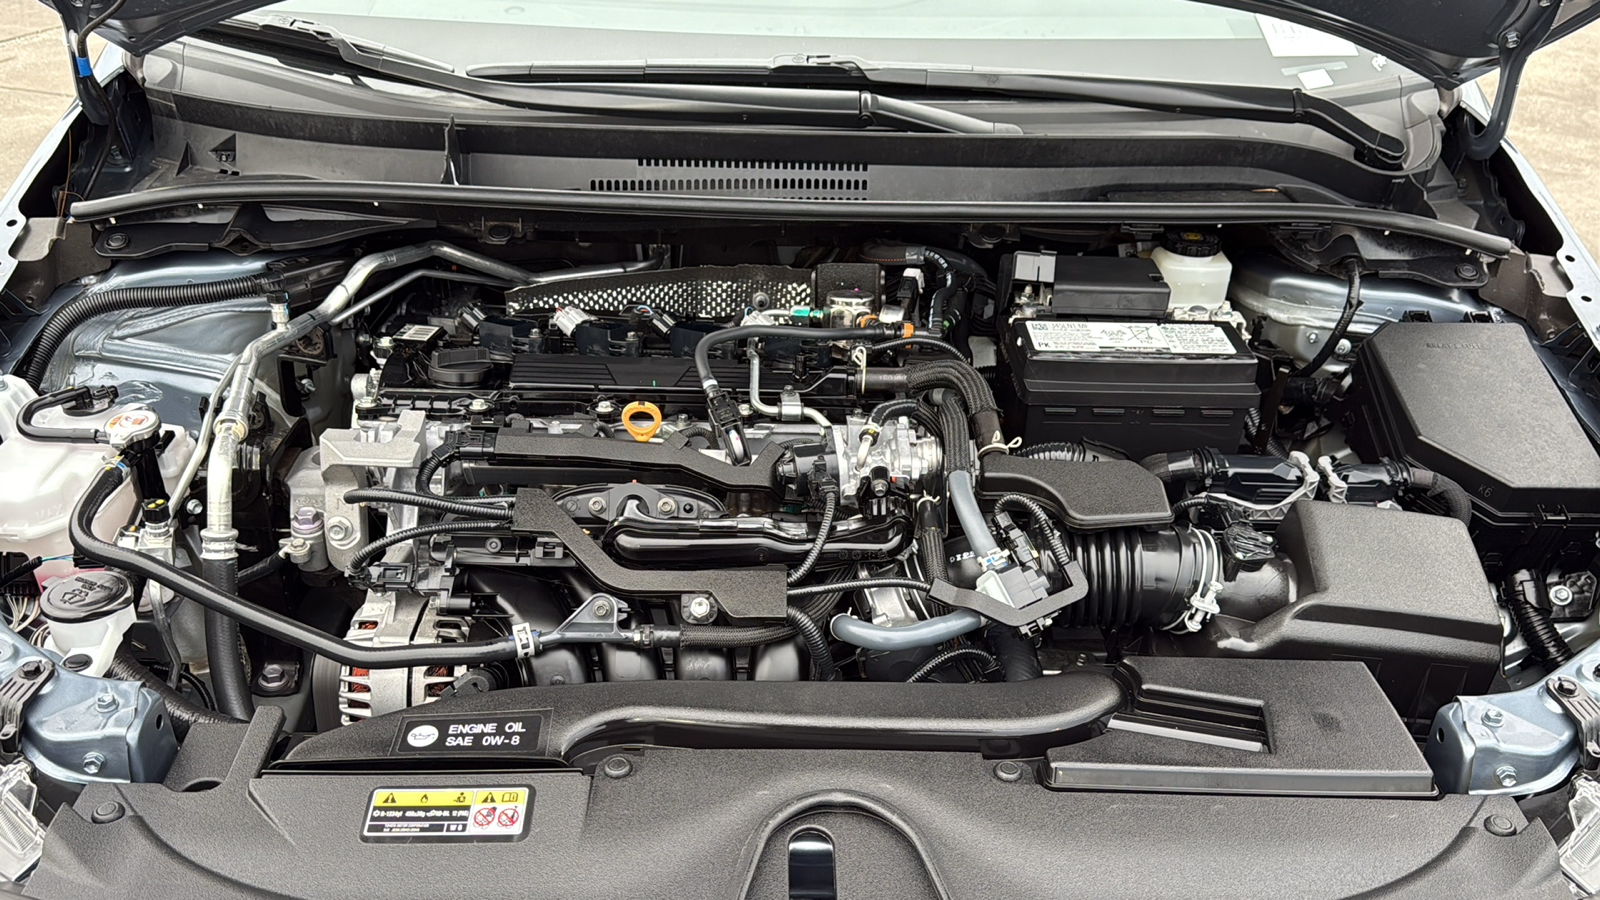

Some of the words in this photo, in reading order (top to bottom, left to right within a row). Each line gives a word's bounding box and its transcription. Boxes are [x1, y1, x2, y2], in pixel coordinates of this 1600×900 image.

[448, 722, 498, 735] ENGINE
[504, 721, 527, 733] OIL
[445, 735, 475, 747] SAE
[481, 734, 521, 746] 0W-8
